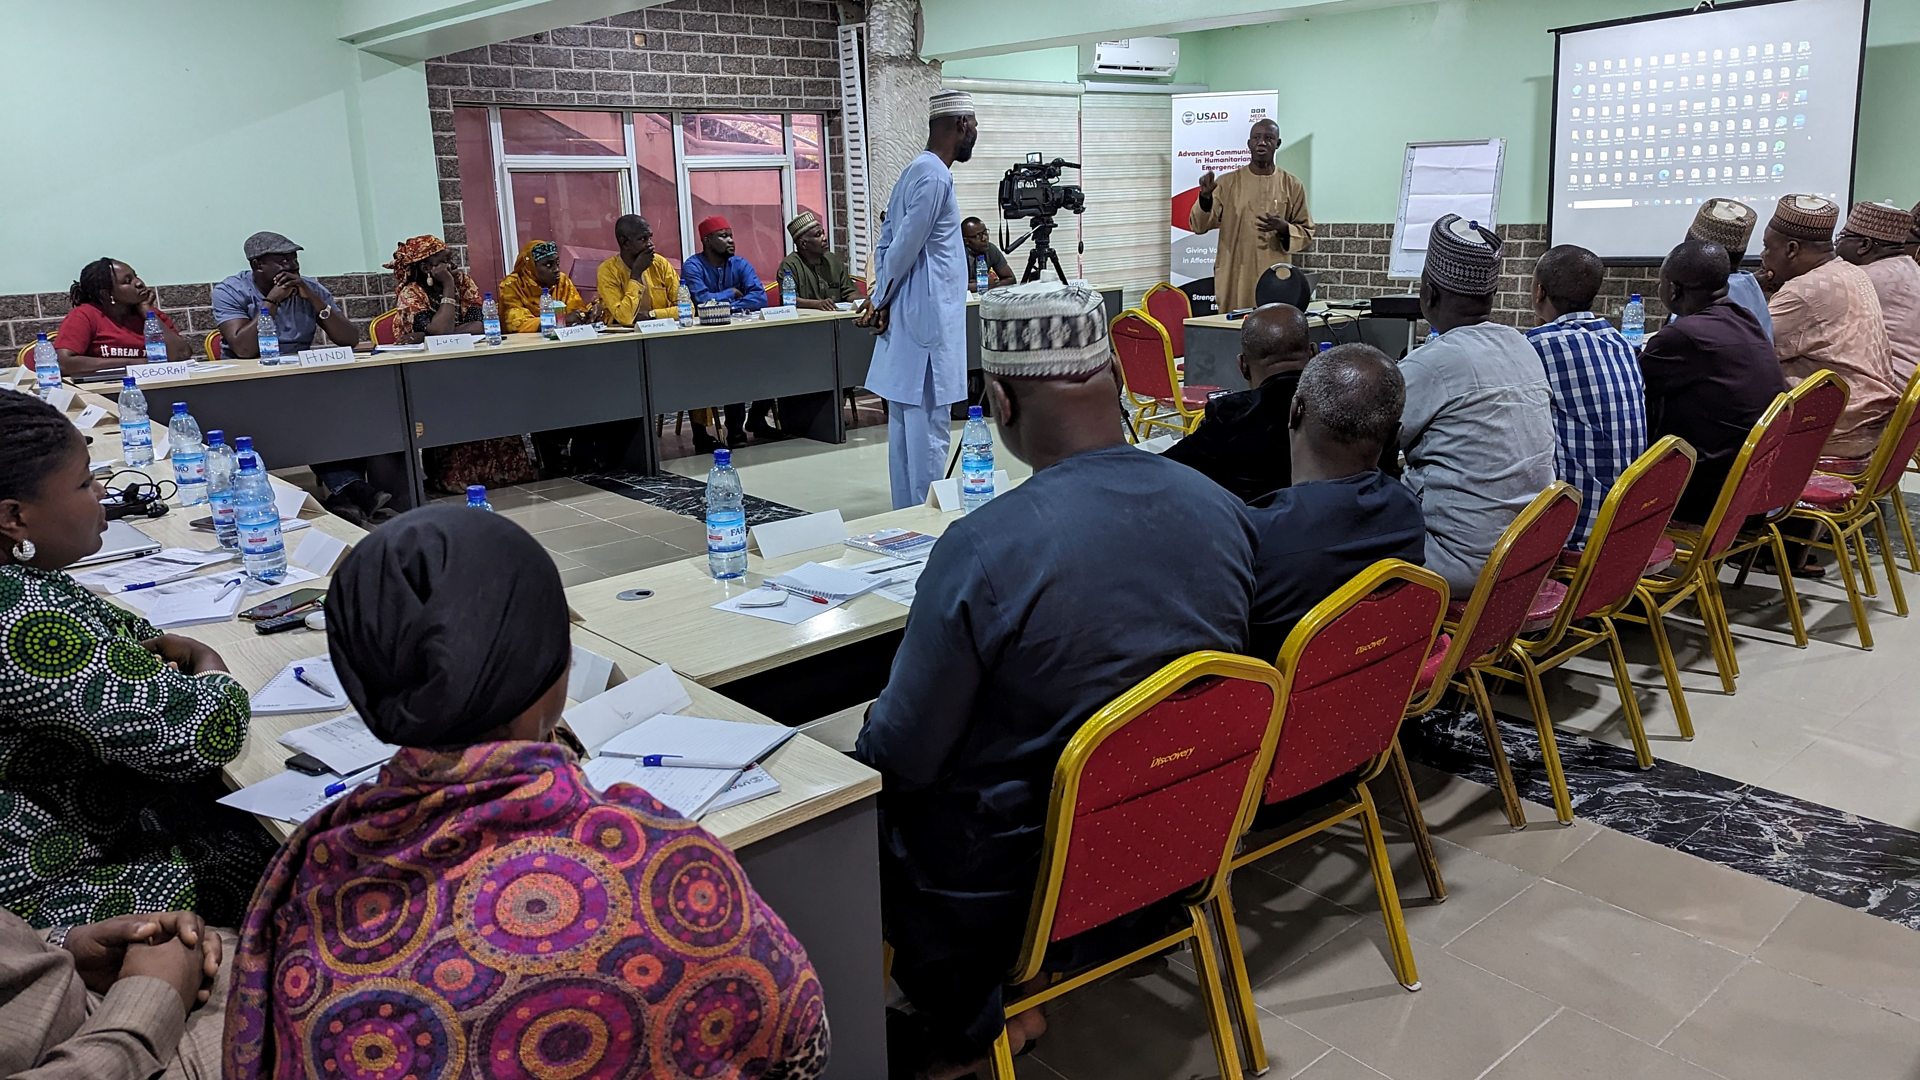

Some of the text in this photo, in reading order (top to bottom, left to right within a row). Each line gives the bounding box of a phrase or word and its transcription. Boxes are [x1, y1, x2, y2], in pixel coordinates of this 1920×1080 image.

[1196, 112, 1228, 120] USAID
[1178, 149, 1214, 157] Advancing
[305, 350, 347, 364] HINDI
[131, 365, 186, 379] DEBORAH
[1150, 746, 1195, 768] Discovery
